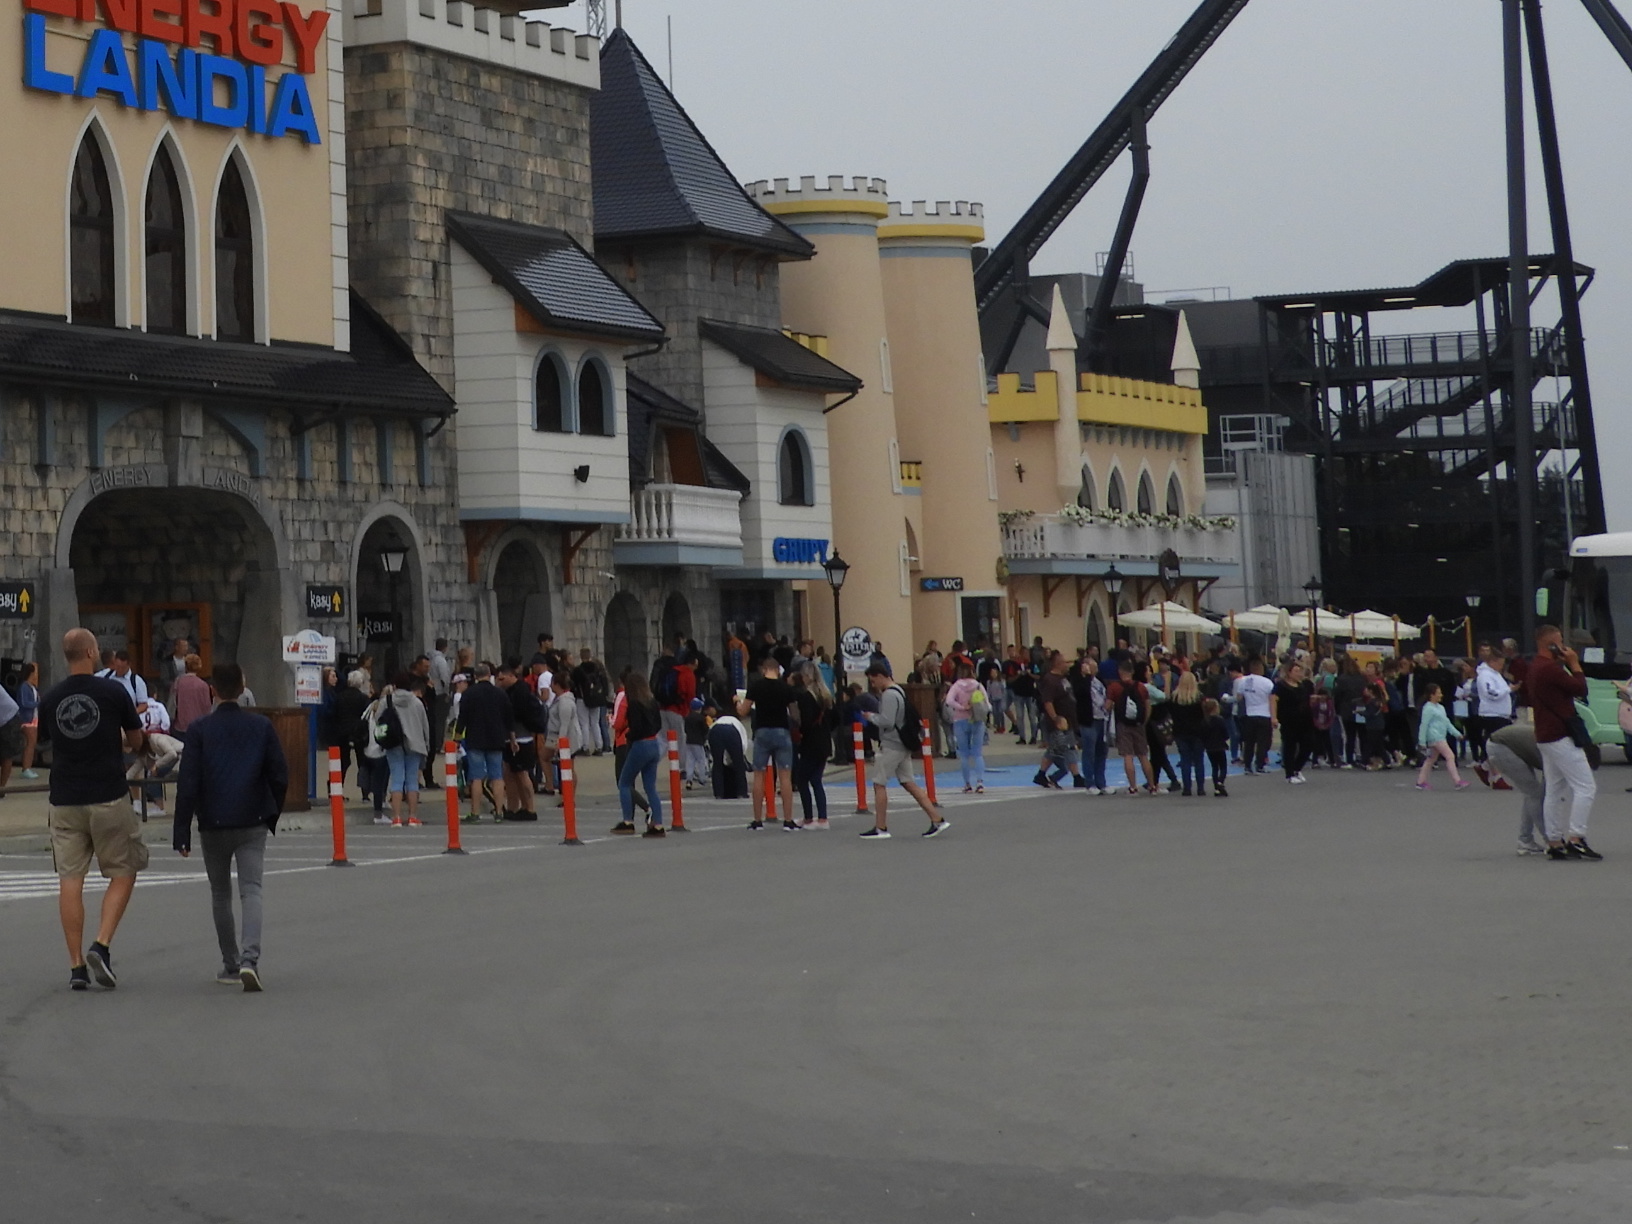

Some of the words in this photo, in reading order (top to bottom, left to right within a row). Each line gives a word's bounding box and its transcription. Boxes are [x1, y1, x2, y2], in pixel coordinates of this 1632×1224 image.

[24, 13, 321, 144] LANDIA
[773, 536, 829, 563] GRUPY
[942, 578, 961, 589] WC
[310, 590, 332, 613] kasy
